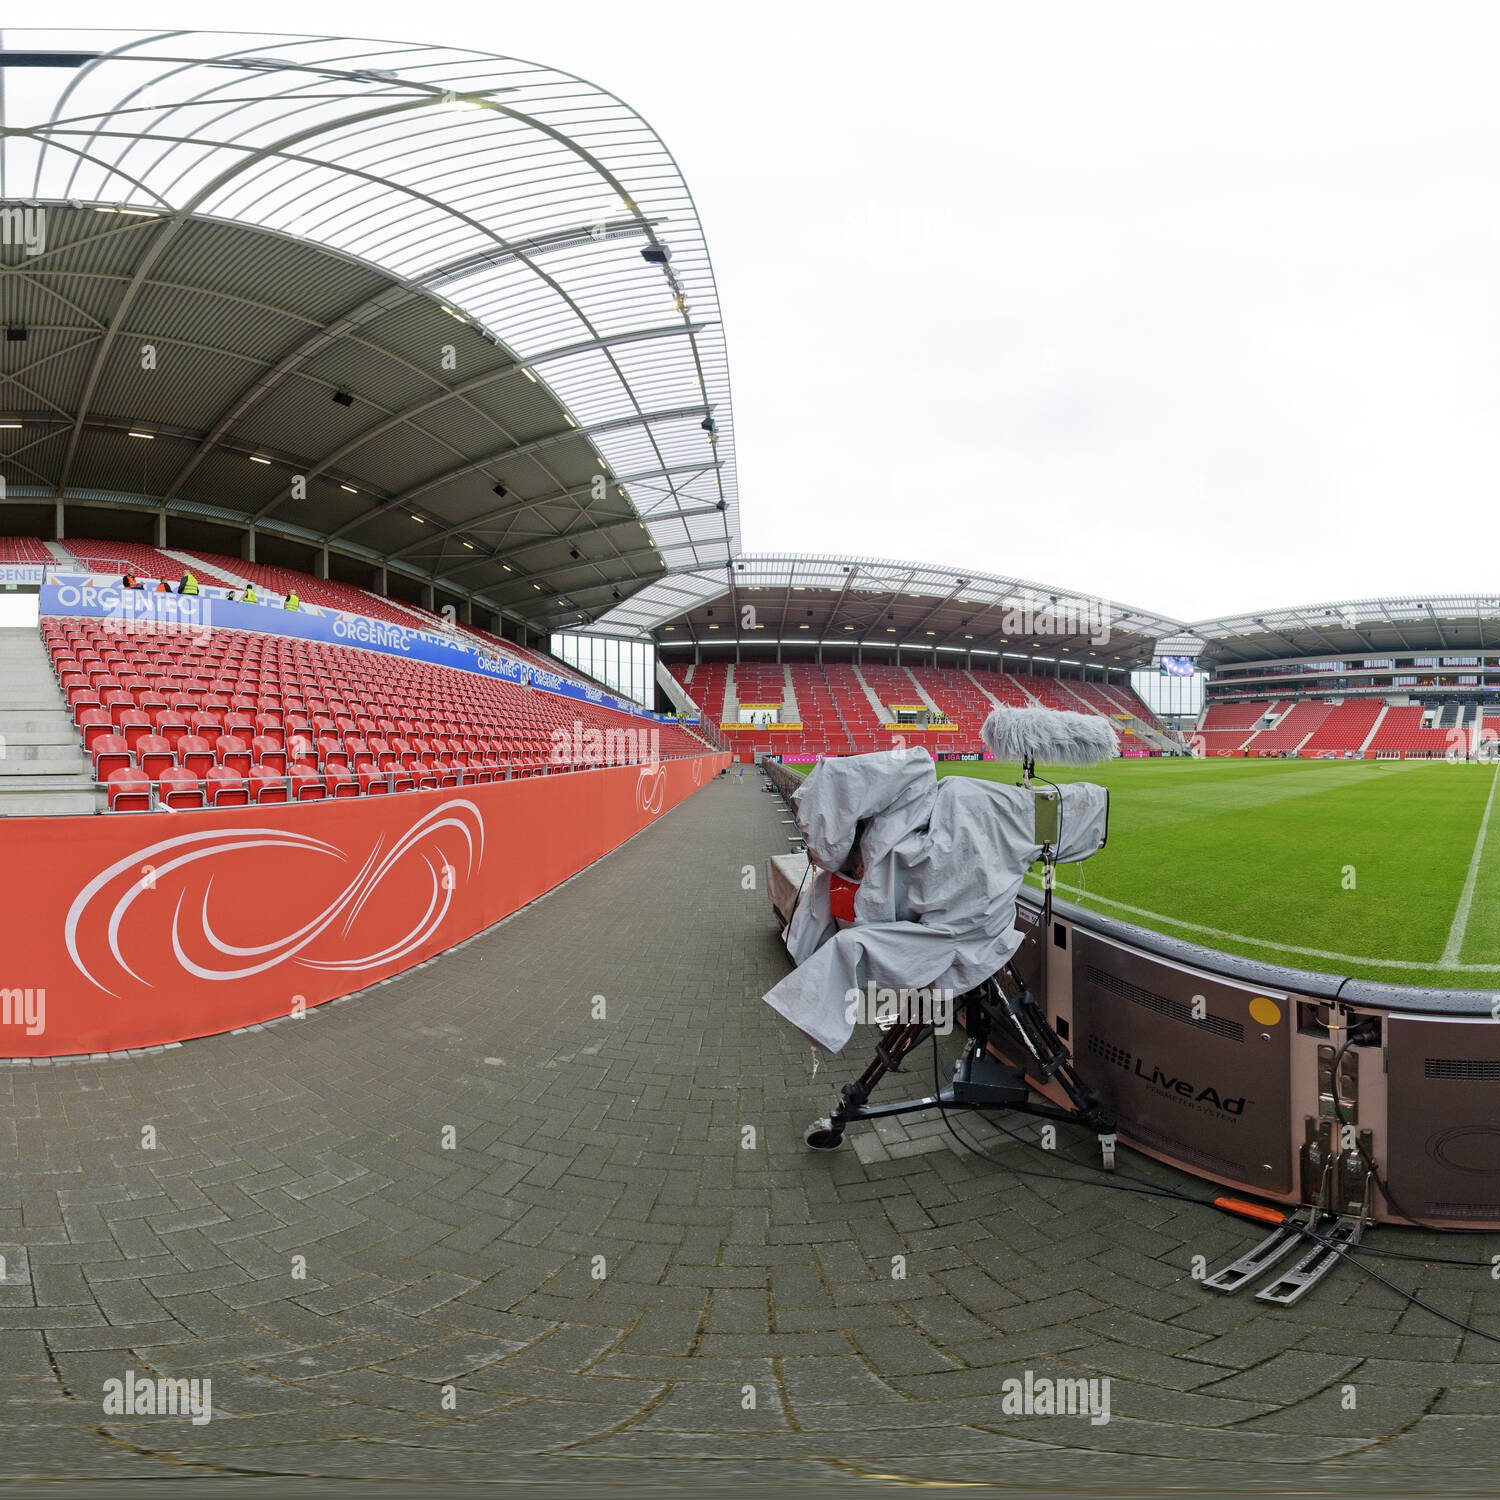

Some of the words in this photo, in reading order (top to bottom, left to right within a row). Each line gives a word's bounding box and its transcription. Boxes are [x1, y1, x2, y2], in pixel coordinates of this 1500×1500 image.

[57, 586, 198, 615] ORGENTEC
[332, 619, 411, 651] ORGENTEC
[477, 656, 518, 678] ORGENTEC
